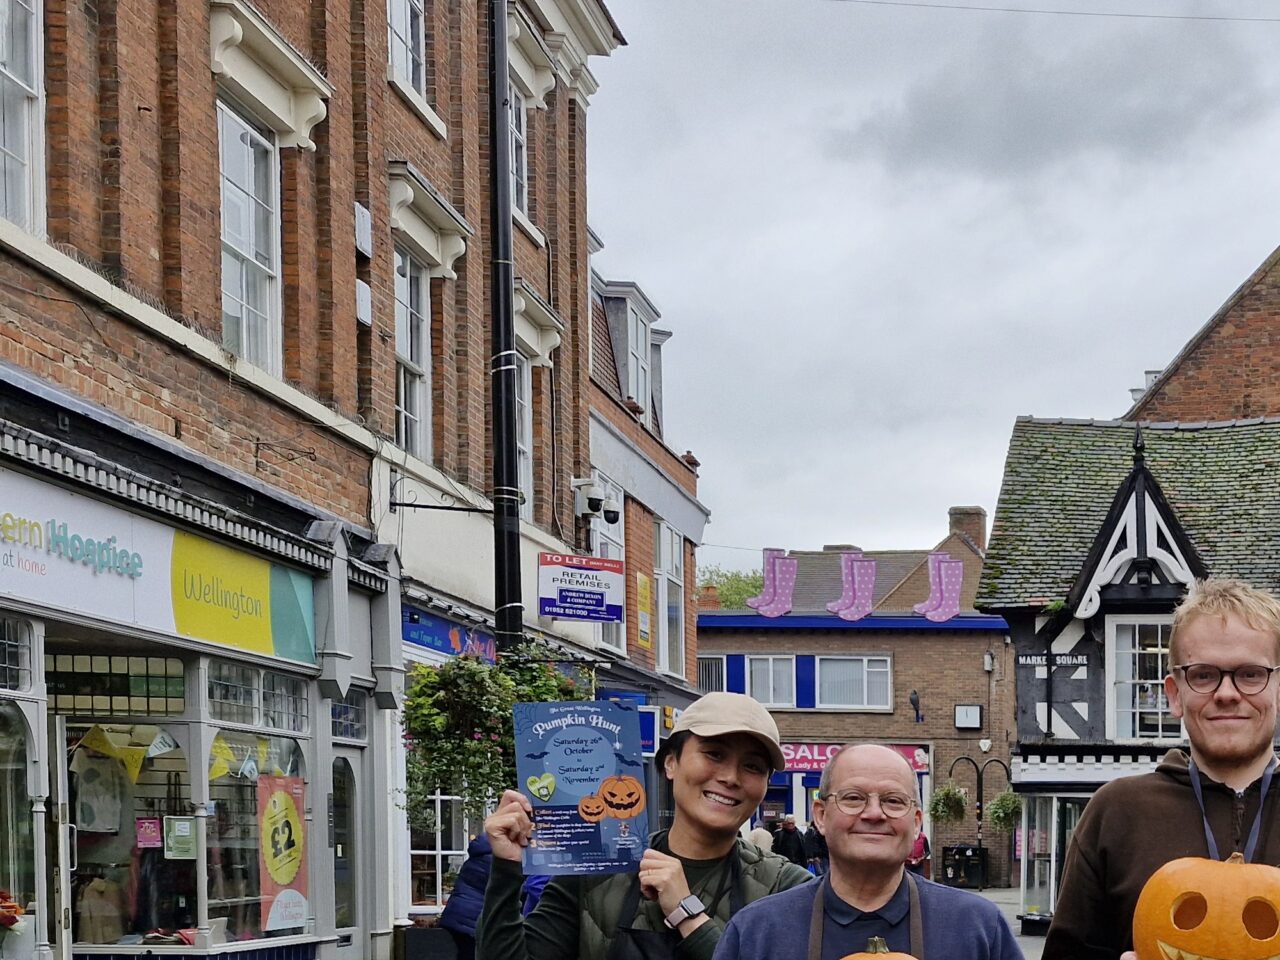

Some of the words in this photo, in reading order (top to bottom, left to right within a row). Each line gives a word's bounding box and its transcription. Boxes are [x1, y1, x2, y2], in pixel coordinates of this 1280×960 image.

[50, 518, 143, 577] Hospice
[2, 549, 14, 568] at
[17, 551, 47, 576] home
[545, 554, 562, 563] TO
[565, 556, 589, 566] LET
[562, 571, 602, 582] RETAIL
[552, 577, 611, 590] PREMISES
[183, 567, 262, 620] Wellington
[571, 597, 596, 605] COMPANY
[1018, 655, 1048, 665] MARKE
[1055, 655, 1088, 665] SQUARE
[532, 713, 586, 740] Pumpkin
[588, 714, 621, 734] Hunt
[553, 736, 590, 748] Saturday
[564, 747, 594, 756] October
[780, 744, 842, 760] SALO
[558, 765, 594, 775] Saturday
[794, 762, 811, 770] Lady
[562, 776, 600, 785] November
[271, 819, 296, 859] £2
